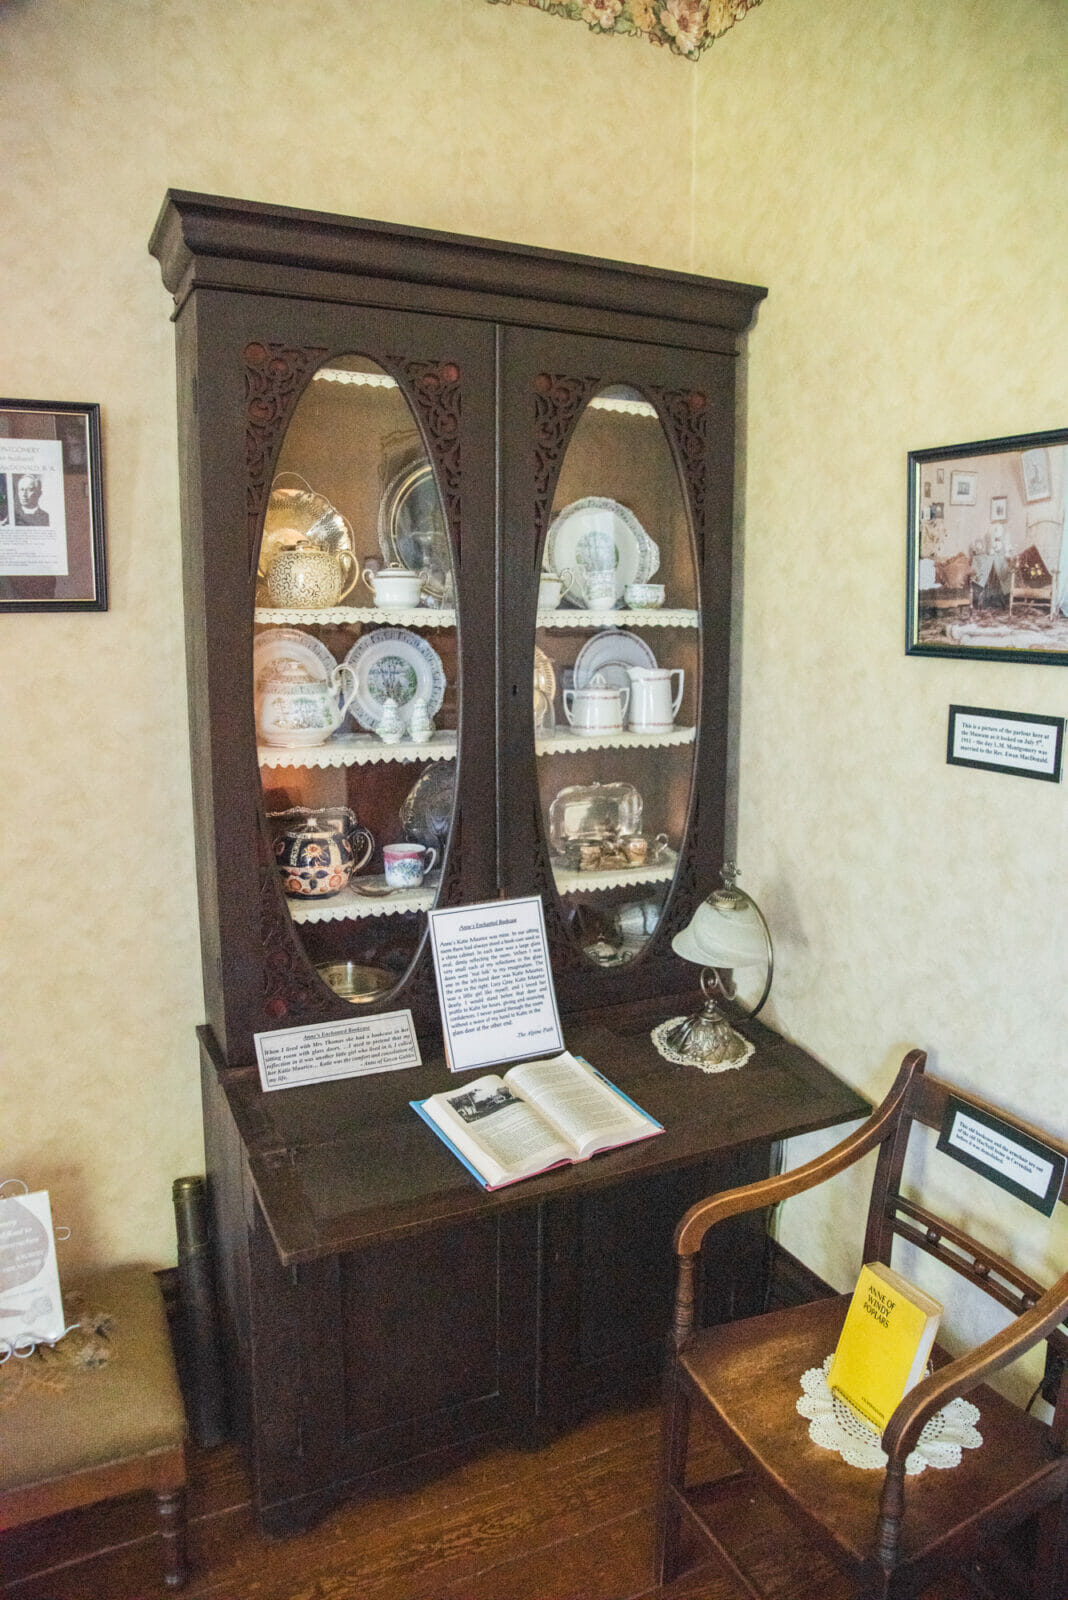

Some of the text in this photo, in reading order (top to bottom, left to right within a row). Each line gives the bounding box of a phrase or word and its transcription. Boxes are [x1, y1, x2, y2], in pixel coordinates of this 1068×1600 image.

[868, 1285, 896, 1310] ANNE OF
[868, 1294, 891, 1317] WINDY
[864, 1301, 890, 1328] POPLARS
